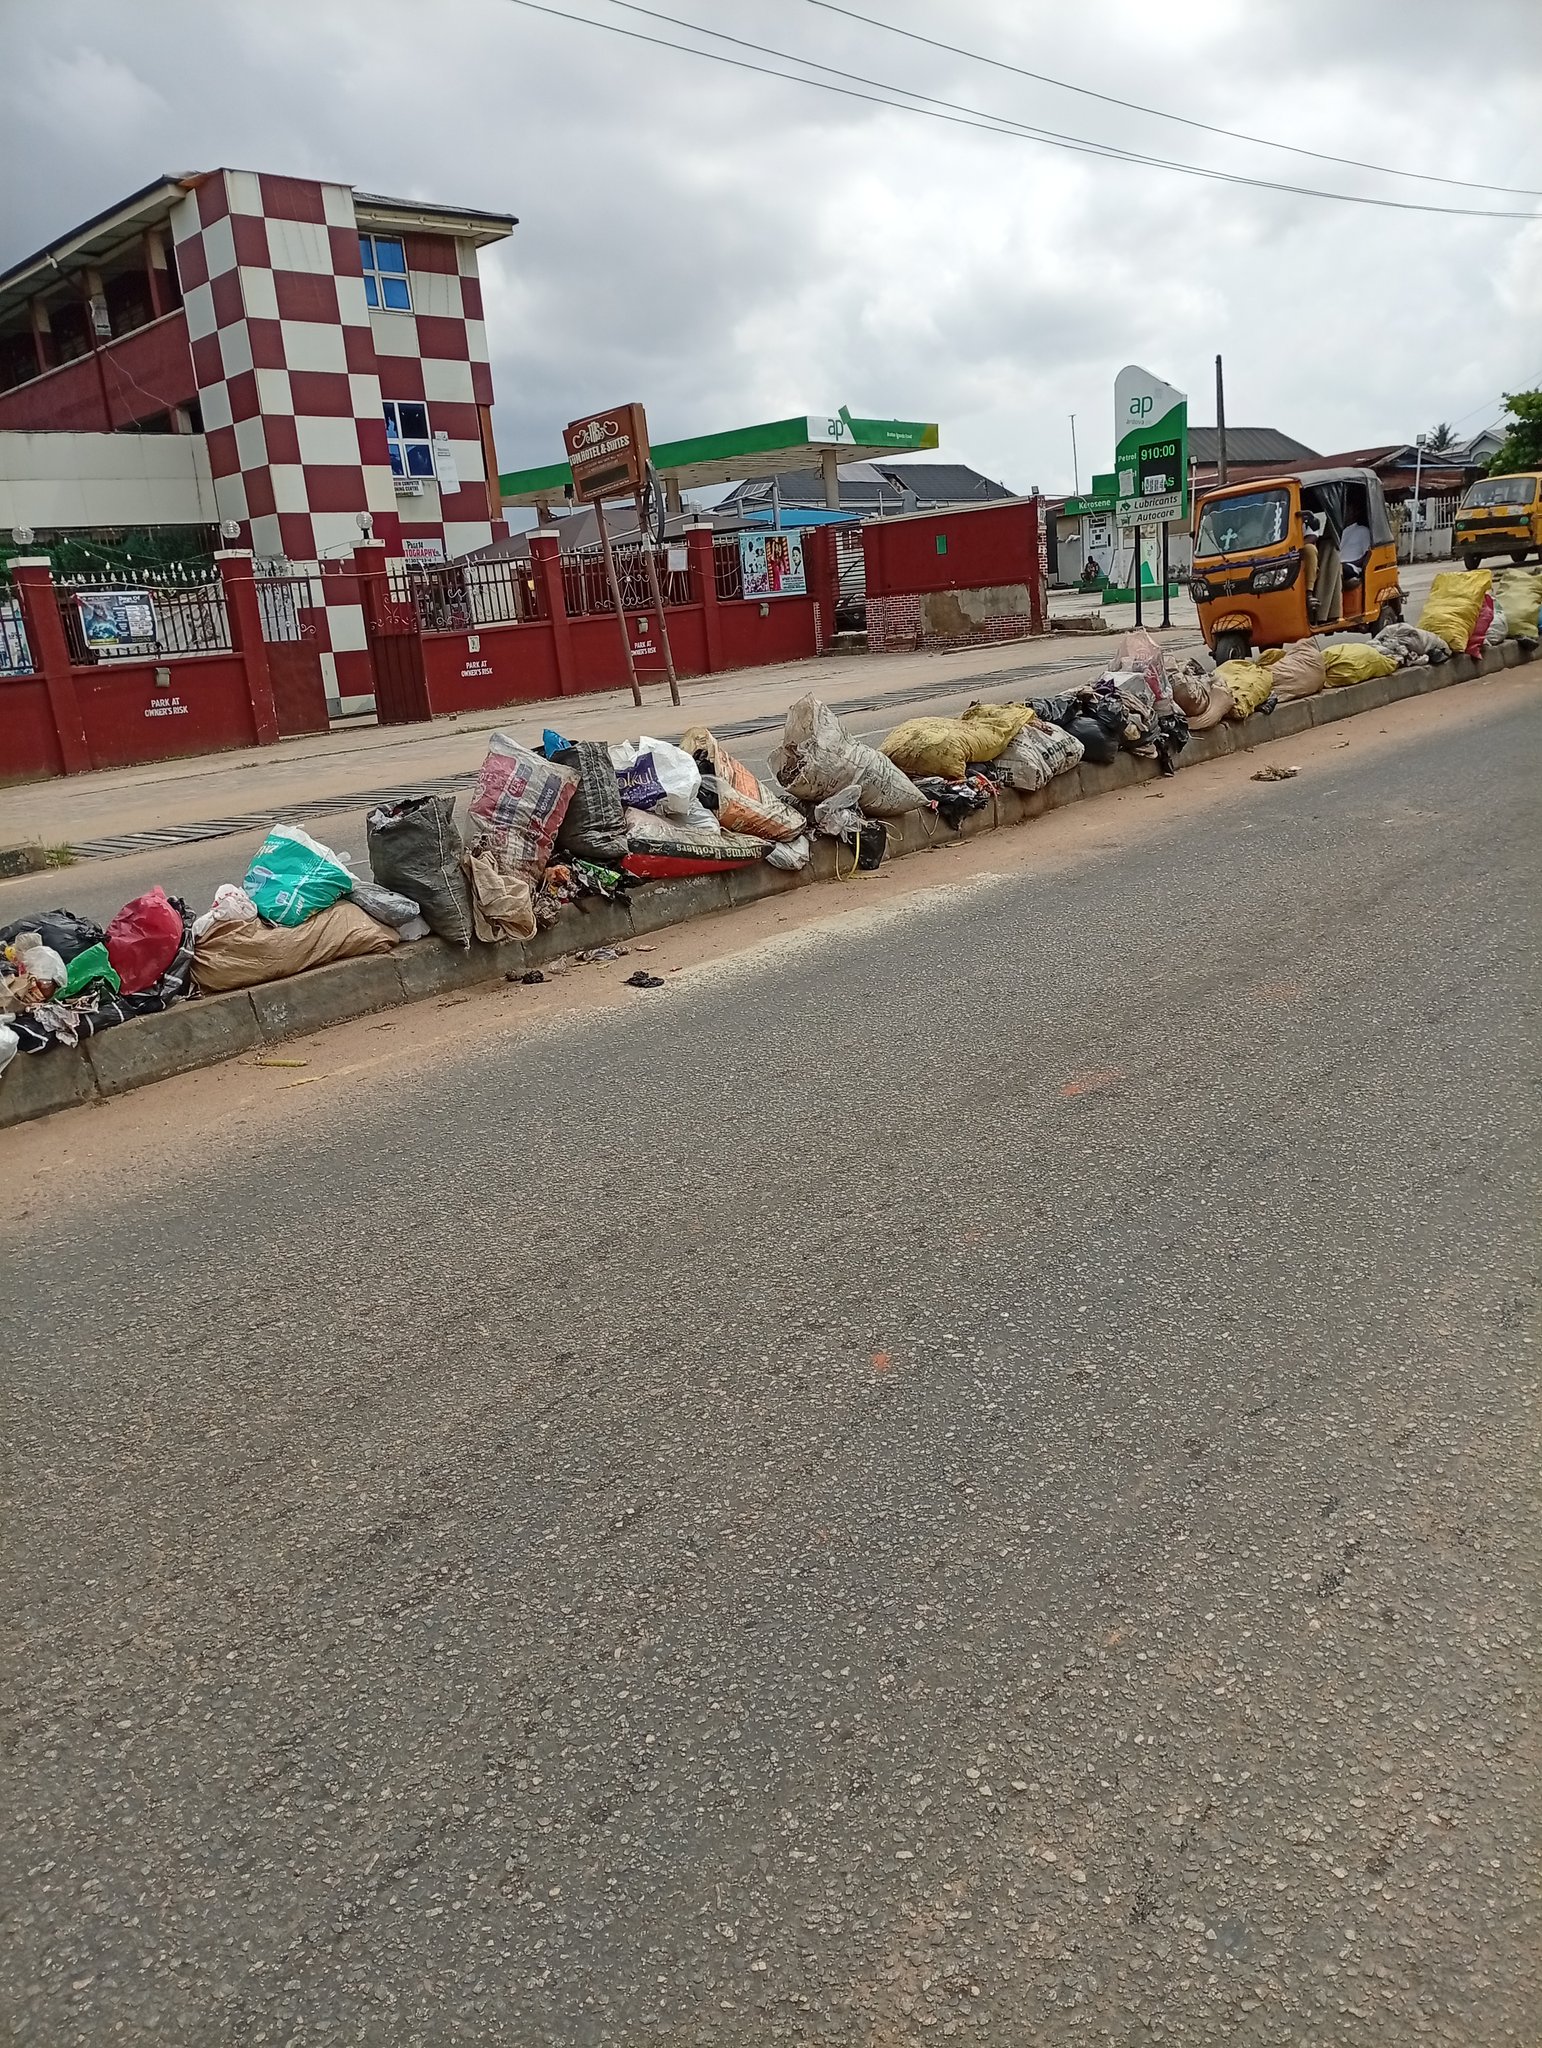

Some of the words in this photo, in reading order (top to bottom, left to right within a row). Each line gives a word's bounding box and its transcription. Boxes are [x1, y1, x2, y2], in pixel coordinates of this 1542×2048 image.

[1129, 396, 1153, 419] ap
[828, 418, 844, 441] ap
[581, 445, 601, 462] HOTEL
[601, 443, 607, 454] &
[607, 435, 630, 452] SUITES
[1118, 453, 1137, 463] Petrol
[1141, 444, 1175, 461] 910:00
[1079, 499, 1111, 510] Kerosene
[1134, 495, 1178, 510] Lubricants
[1136, 508, 1175, 522] Autocare
[634, 641, 645, 649] PARK
[647, 647, 657, 655] RISK
[466, 661, 480, 669] PARK
[481, 660, 487, 668] AT
[461, 669, 481, 677] OWNER'S
[482, 667, 493, 675] RISK
[151, 698, 170, 708] PARK
[171, 697, 180, 706] AT
[144, 707, 173, 717] OWNER'S
[172, 705, 189, 715] RISK
[676, 843, 722, 860] Brothers
[725, 846, 763, 860] Sharma
